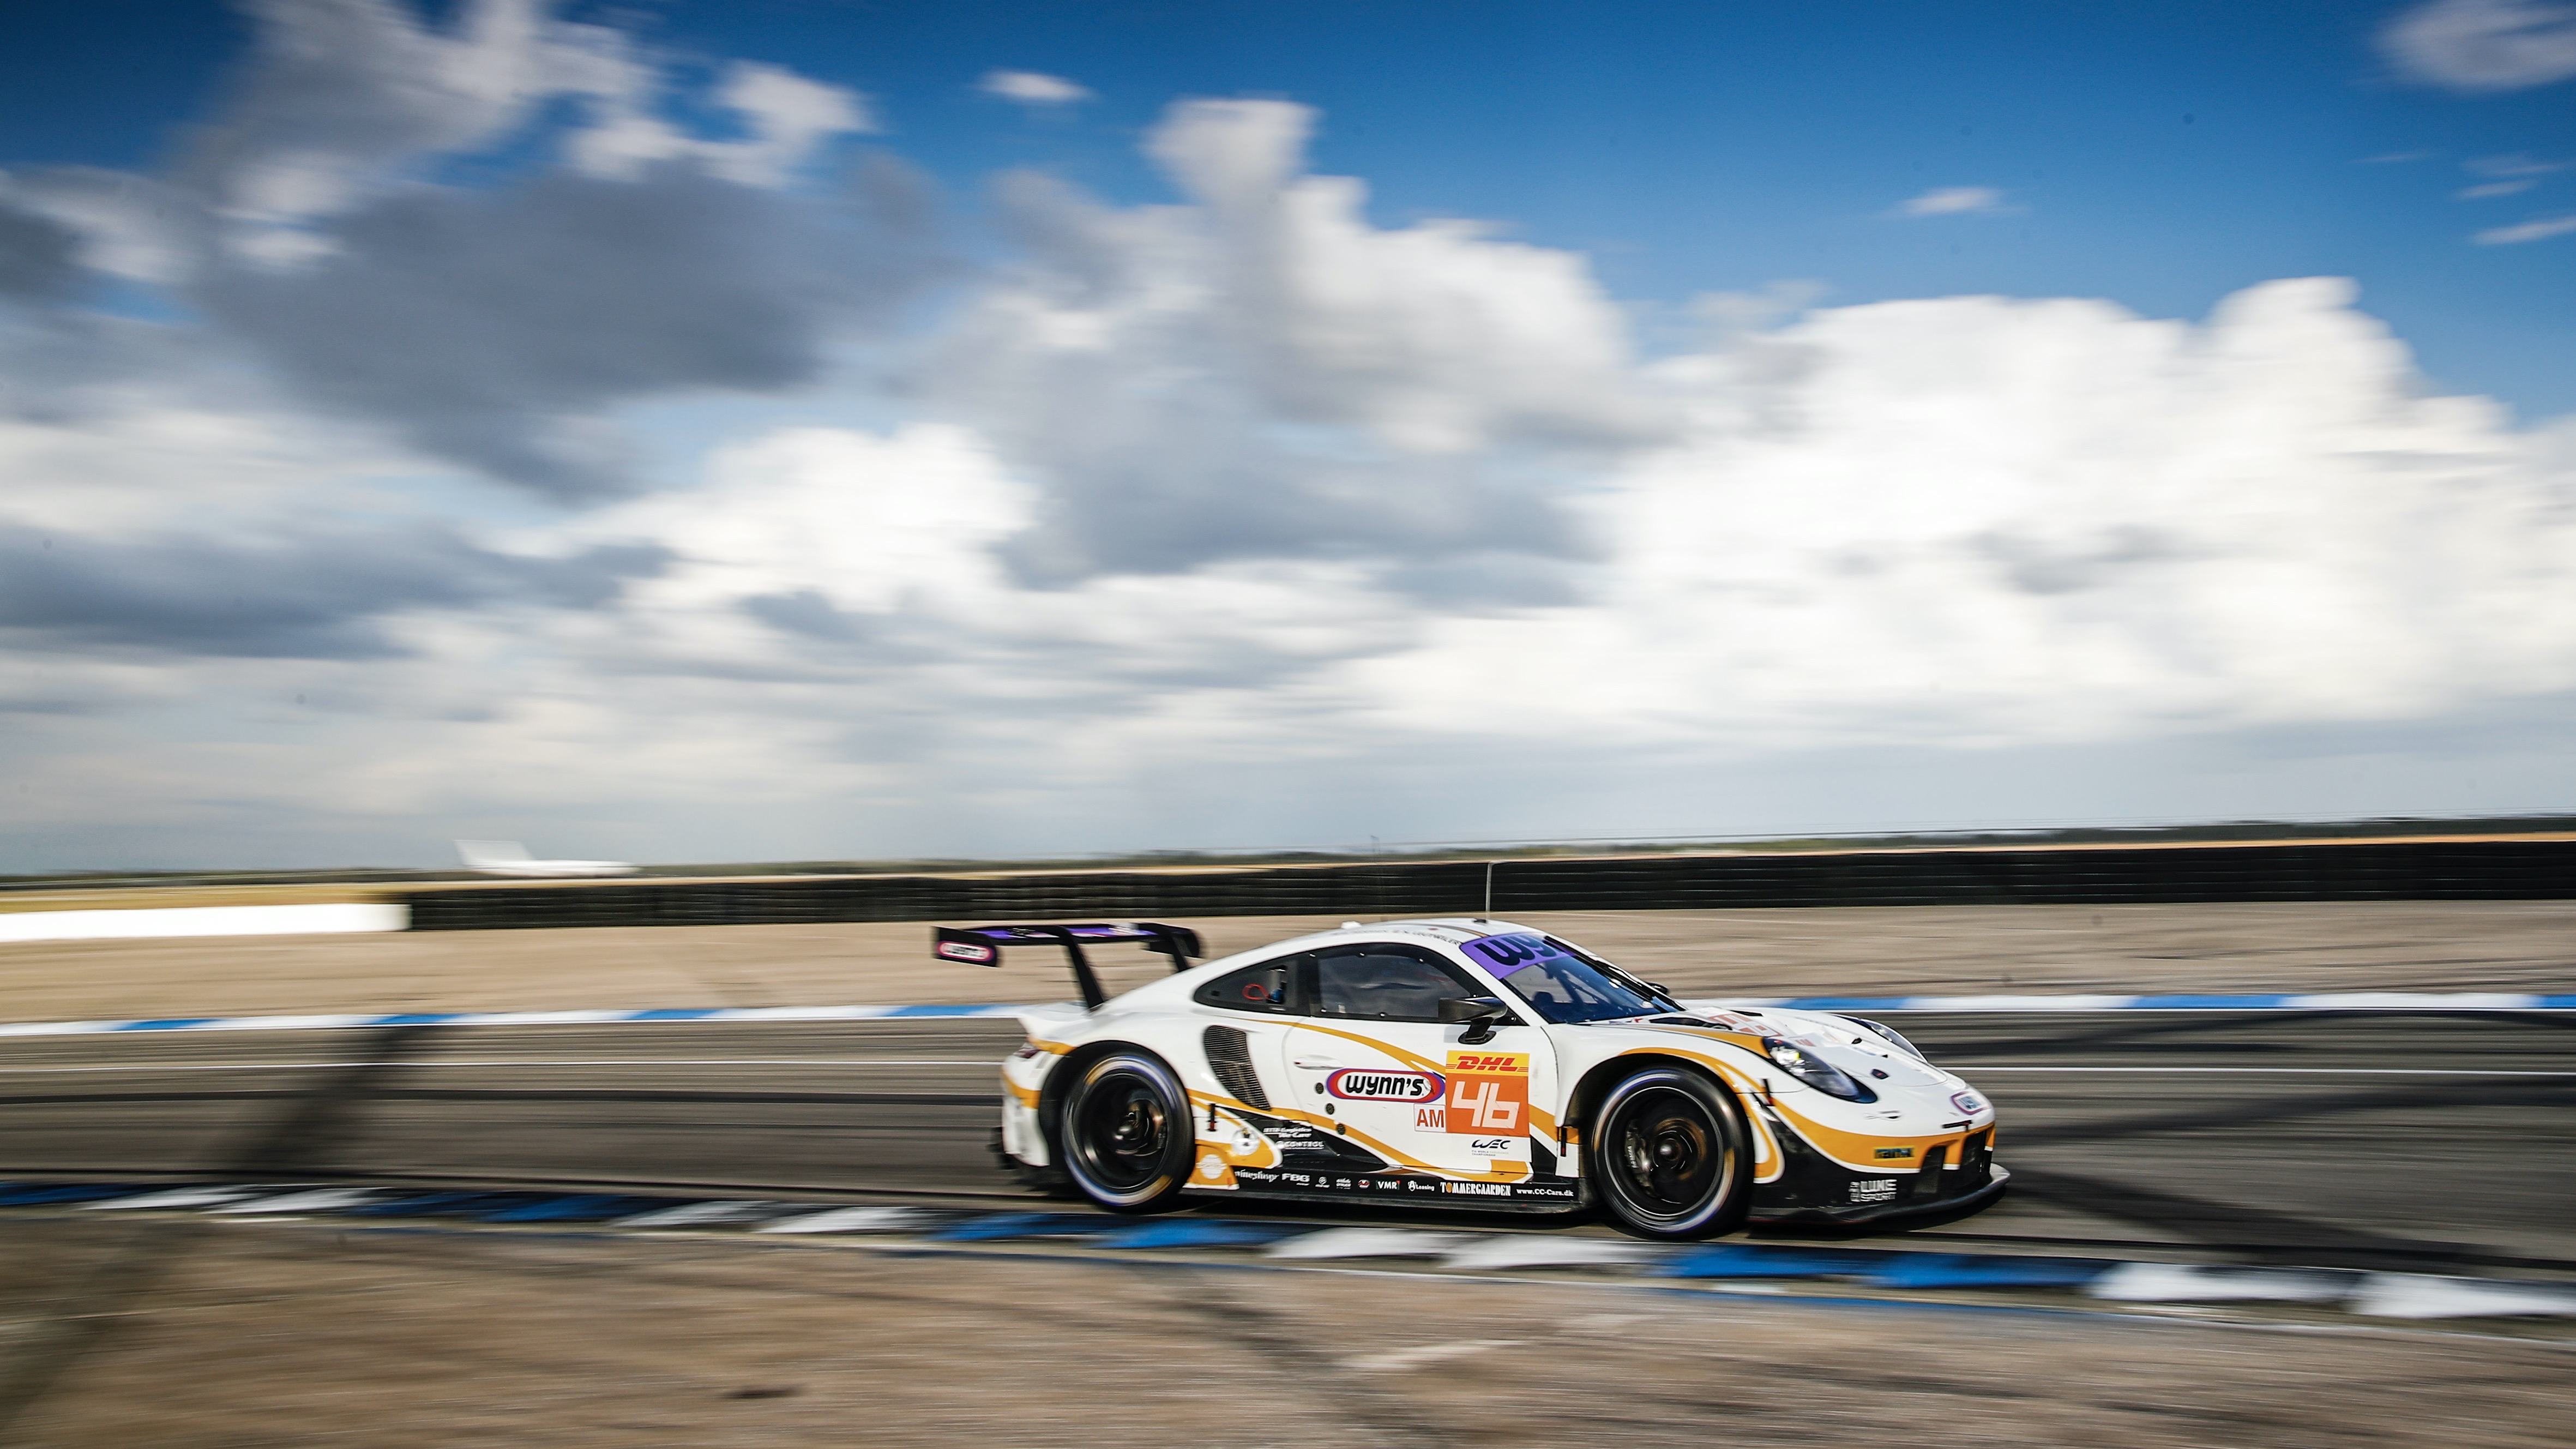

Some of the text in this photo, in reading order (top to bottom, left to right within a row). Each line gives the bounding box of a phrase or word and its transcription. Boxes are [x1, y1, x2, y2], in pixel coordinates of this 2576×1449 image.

[1456, 1056, 1518, 1072] DHL
[1451, 1081, 1520, 1129] 46
[1416, 1109, 1445, 1128] AM
[1472, 1139, 1510, 1149] WEC
[1377, 1181, 1397, 1189] VMR
[1440, 1182, 1511, 1196] TOMMERGAARDEN
